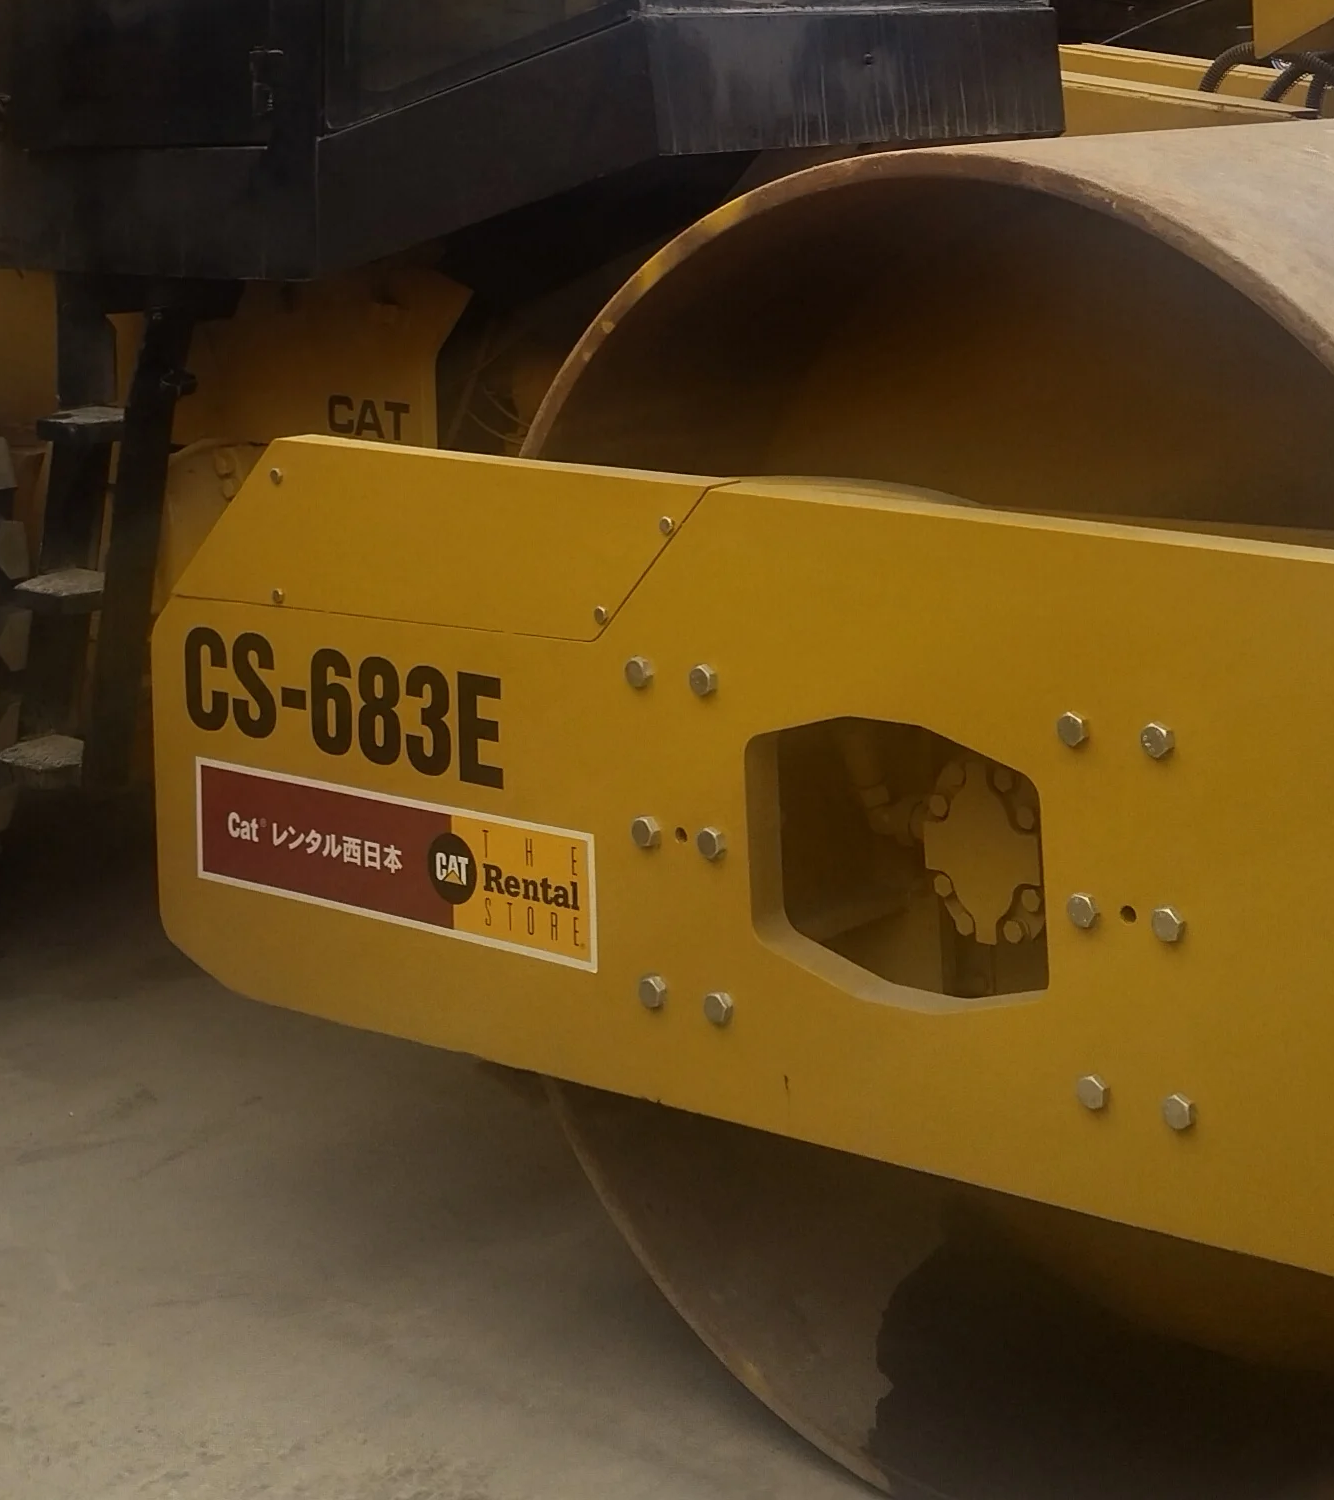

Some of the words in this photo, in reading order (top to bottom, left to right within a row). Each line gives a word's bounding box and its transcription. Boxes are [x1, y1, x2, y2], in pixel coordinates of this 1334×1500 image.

[328, 394, 411, 441] CAT
[184, 627, 504, 790] CS-683E
[228, 811, 260, 843] Cat
[272, 822, 404, 874] レンタル西日本
[435, 852, 469, 886] CAT
[482, 863, 580, 911] Rental
[485, 897, 580, 947] STORE
